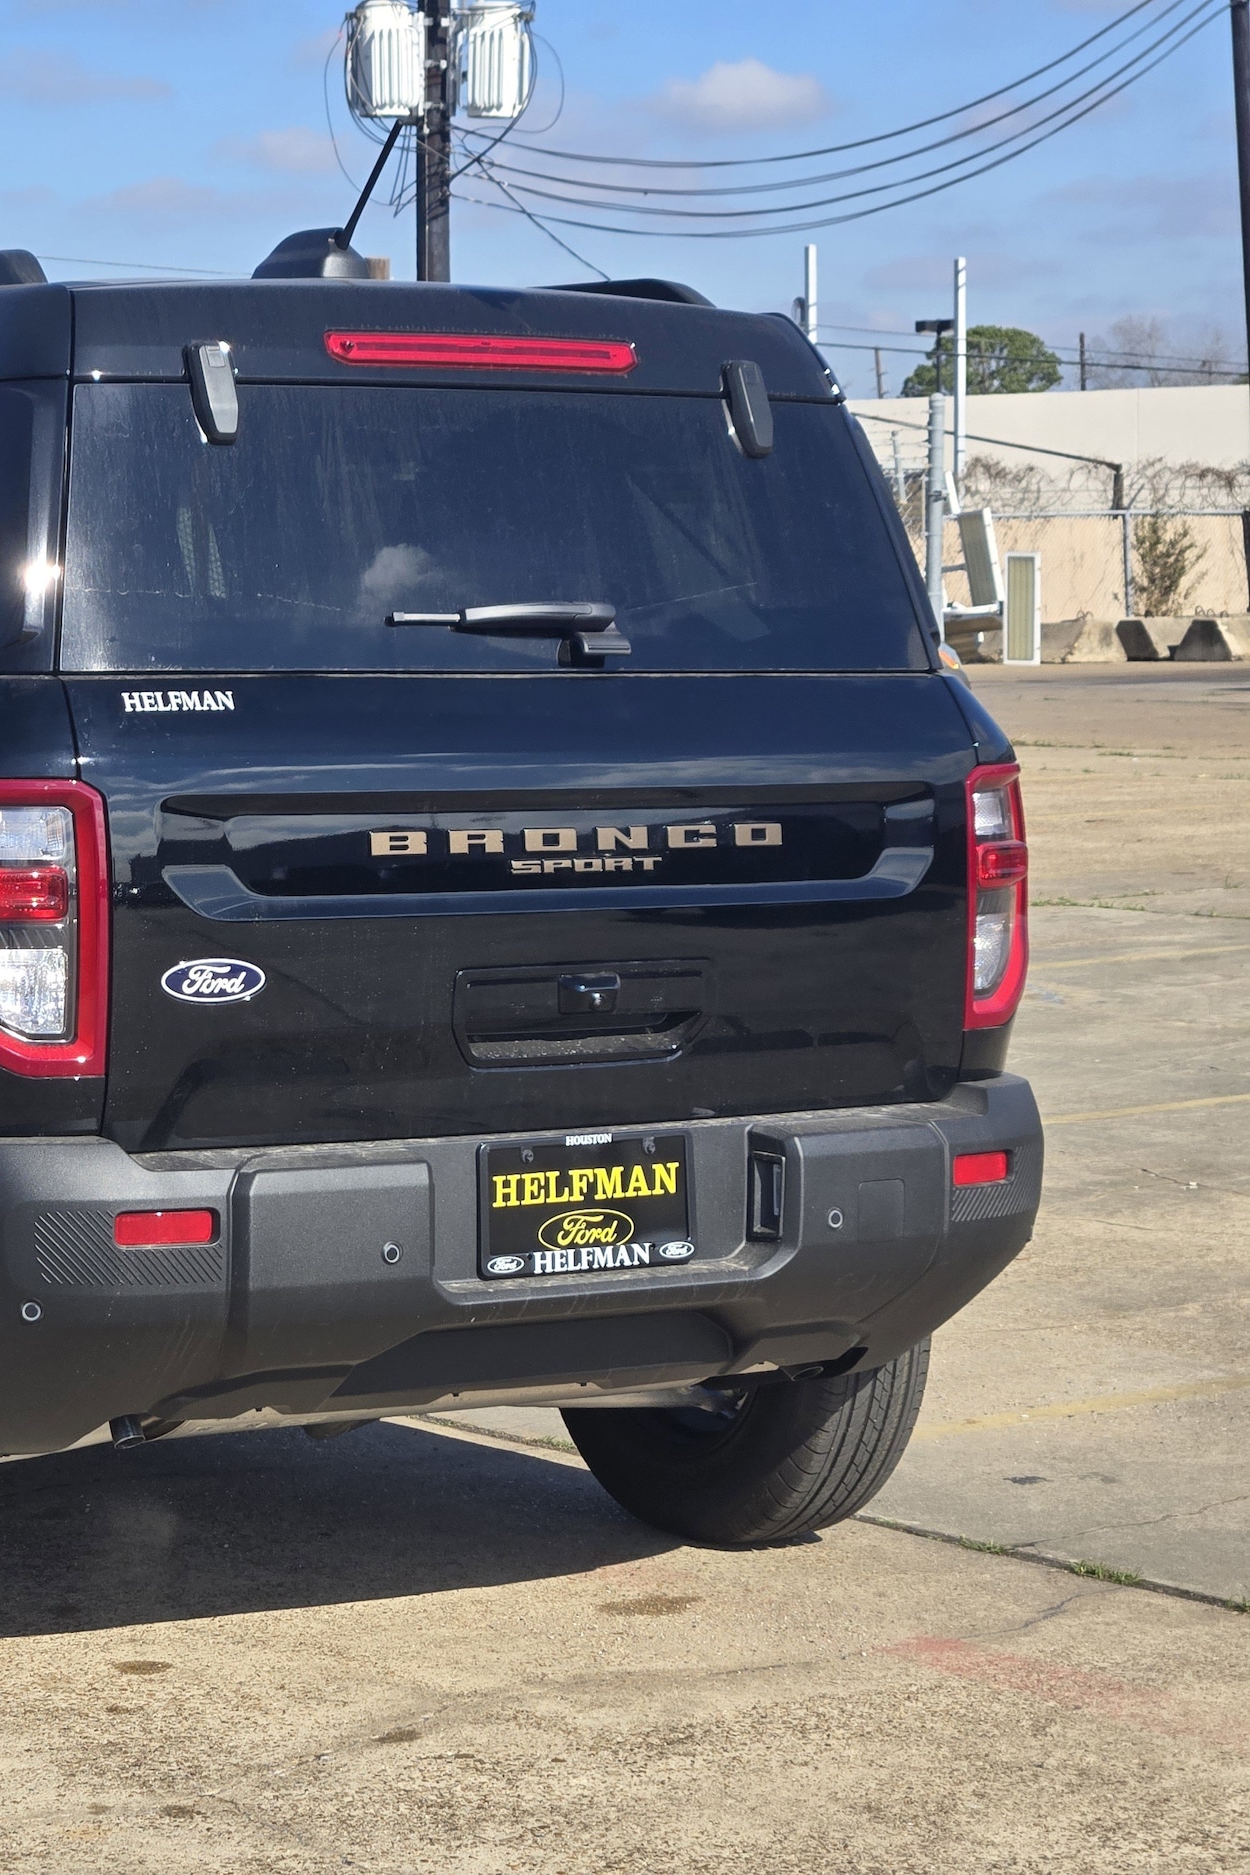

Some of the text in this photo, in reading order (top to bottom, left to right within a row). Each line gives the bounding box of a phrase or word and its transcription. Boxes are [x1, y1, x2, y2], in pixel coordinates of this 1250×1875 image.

[121, 689, 235, 712] HELFMAN
[369, 822, 784, 857] BRONCO
[511, 855, 663, 875] SPORT
[181, 964, 247, 995] Ford
[565, 1133, 613, 1147] HOUSTON
[492, 1162, 680, 1208] HELFMAN
[557, 1215, 618, 1245] Ford
[533, 1243, 653, 1274] HELFMAN
[665, 1244, 689, 1257] Ford
[492, 1258, 518, 1272] Ford
